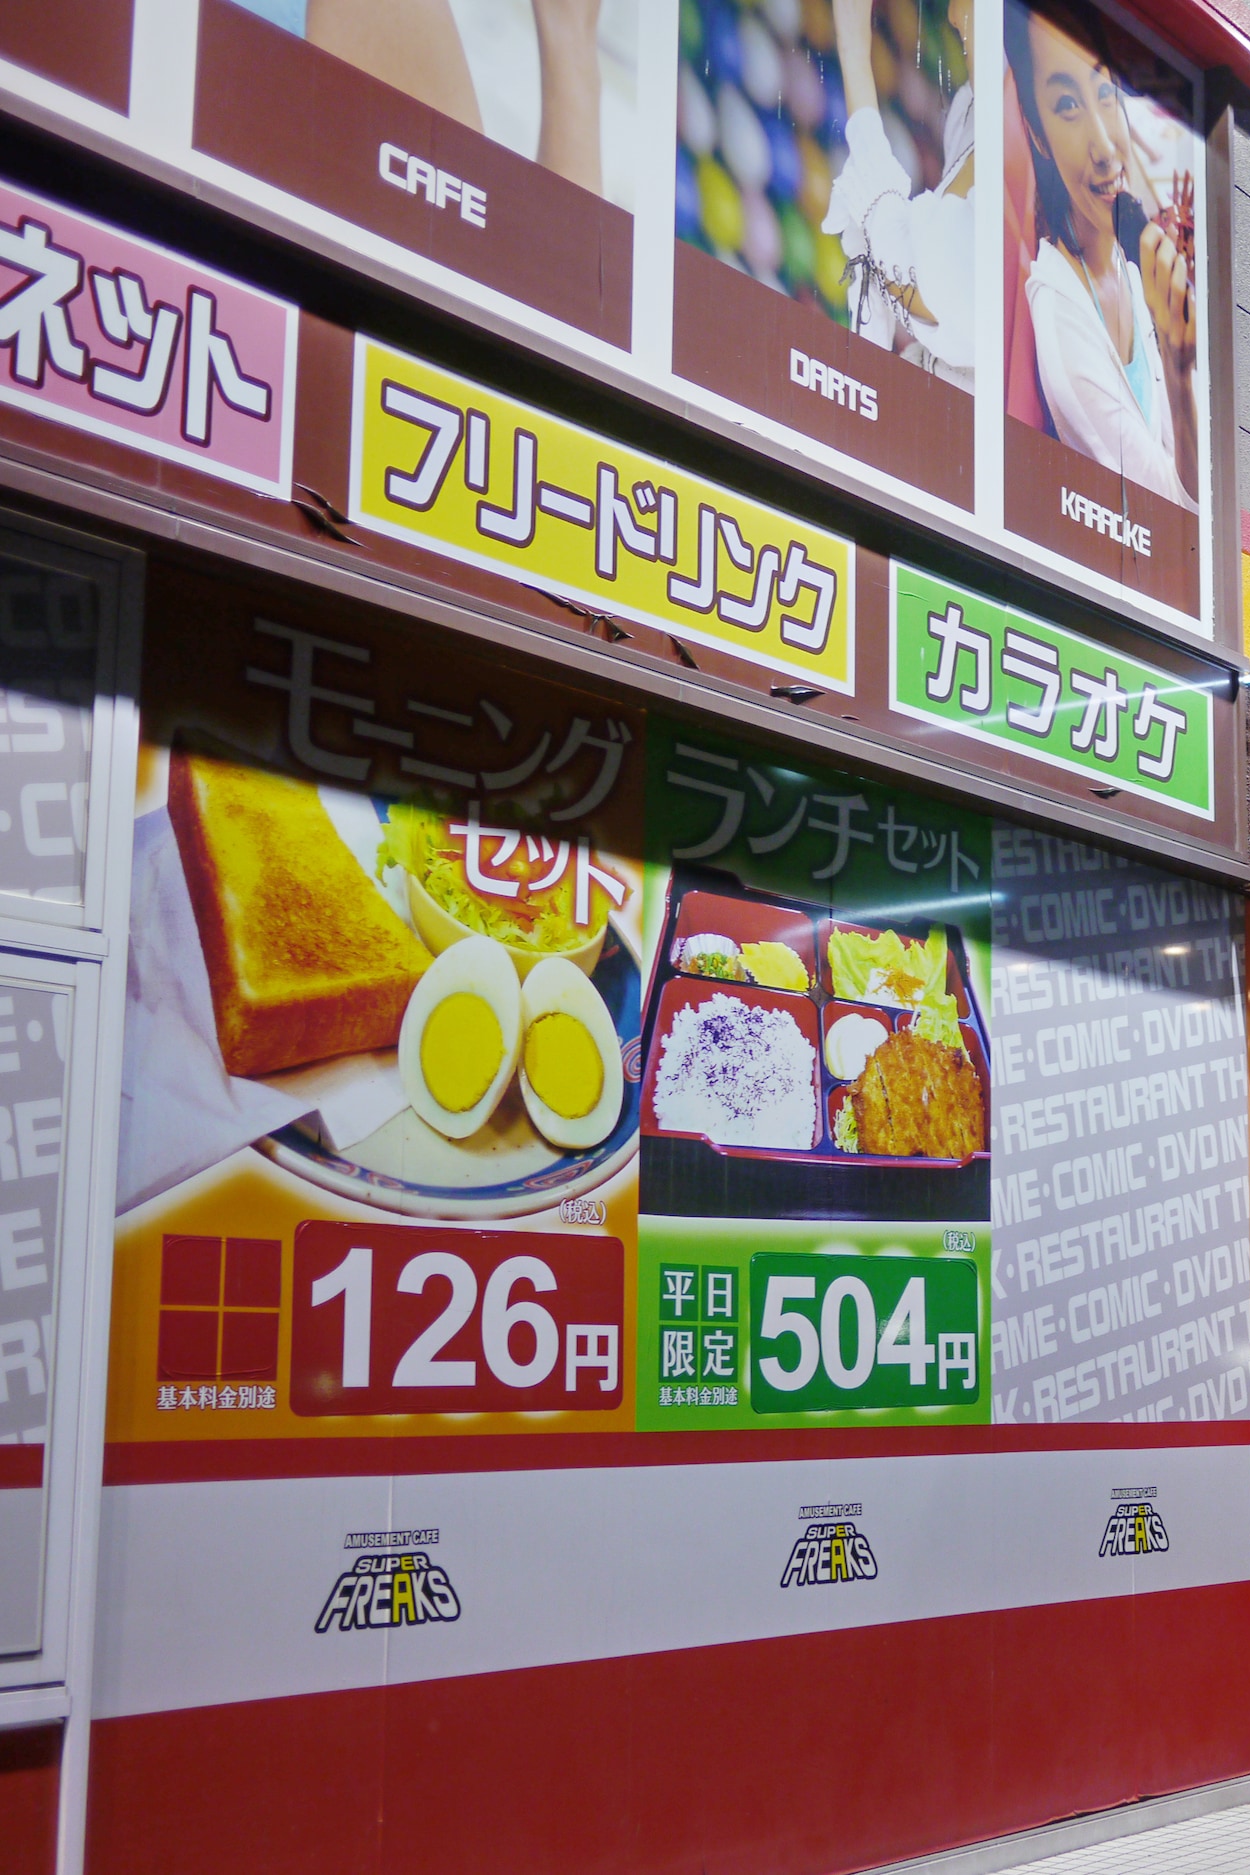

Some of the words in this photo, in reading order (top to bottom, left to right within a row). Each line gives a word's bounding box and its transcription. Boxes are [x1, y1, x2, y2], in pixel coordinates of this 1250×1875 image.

[379, 142, 487, 229] CAFE
[790, 346, 878, 422] DARTS
[381, 378, 836, 655] フリードリンク
[1061, 486, 1151, 557] KARAOKE
[245, 616, 632, 822] モーニング
[926, 603, 1187, 782] カラオケ
[667, 741, 980, 893] ランチセット
[448, 797, 627, 926] セット
[992, 942, 1191, 1017] RESTAURANT
[1036, 1015, 1131, 1077] COMIC
[1000, 1063, 1206, 1155] RESTAURANT
[1052, 1142, 1147, 1211] COMIC
[1016, 1184, 1221, 1293] RESTAURANT
[663, 1270, 733, 1317] 平日
[1068, 1269, 1162, 1344] COMIC
[663, 1330, 735, 1378] 限定
[1033, 1305, 1235, 1423] RESTAURANT
[157, 1385, 277, 1411] 基本料金別途
[658, 1386, 738, 1408] 基本料金別途
[344, 1531, 411, 1549] AMUSEMENT
[412, 1529, 439, 1545] CAFE
[805, 1523, 857, 1539] SUPER
[1099, 1513, 1170, 1557] FREAKS
[1116, 1503, 1153, 1517] SUPER
[353, 1552, 431, 1574] SUPER
[780, 1535, 878, 1588] FREAKS
[314, 1568, 461, 1634] FREAKS
